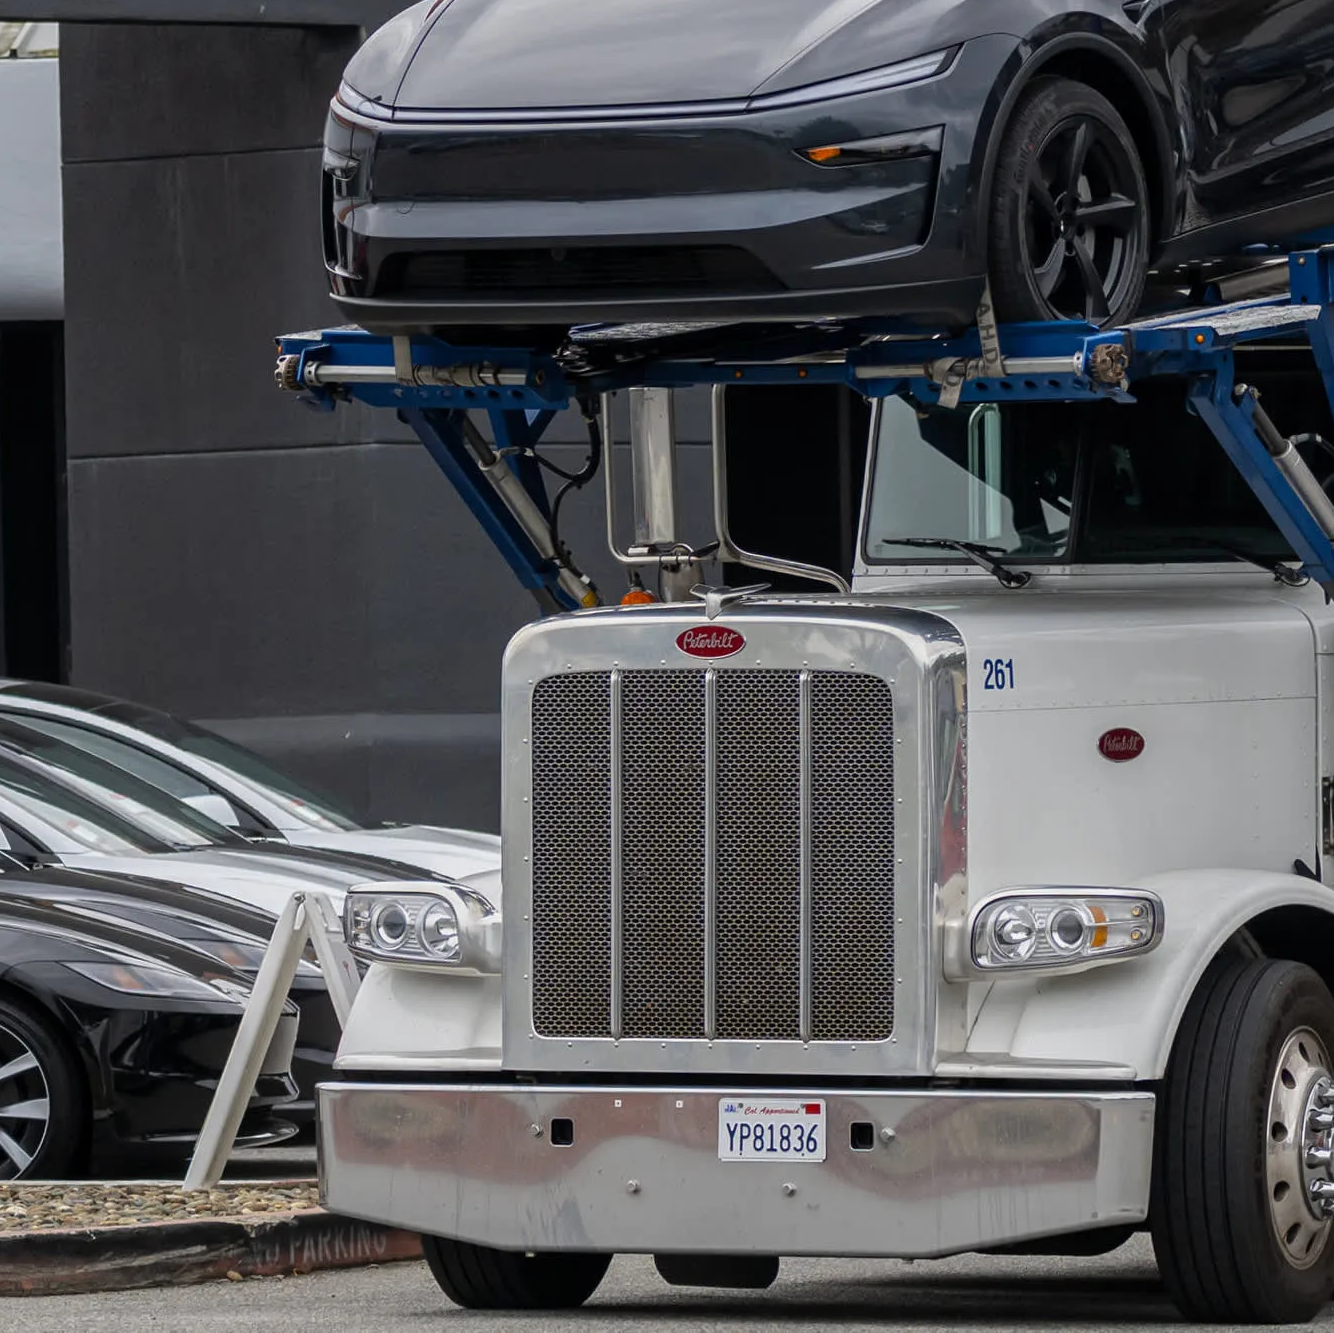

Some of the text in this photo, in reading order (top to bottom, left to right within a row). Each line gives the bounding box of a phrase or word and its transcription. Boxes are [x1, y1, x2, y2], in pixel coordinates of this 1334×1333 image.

[683, 630, 739, 650] Peterbilt
[983, 658, 1014, 690] 261
[726, 1122, 819, 1153] YP81836
